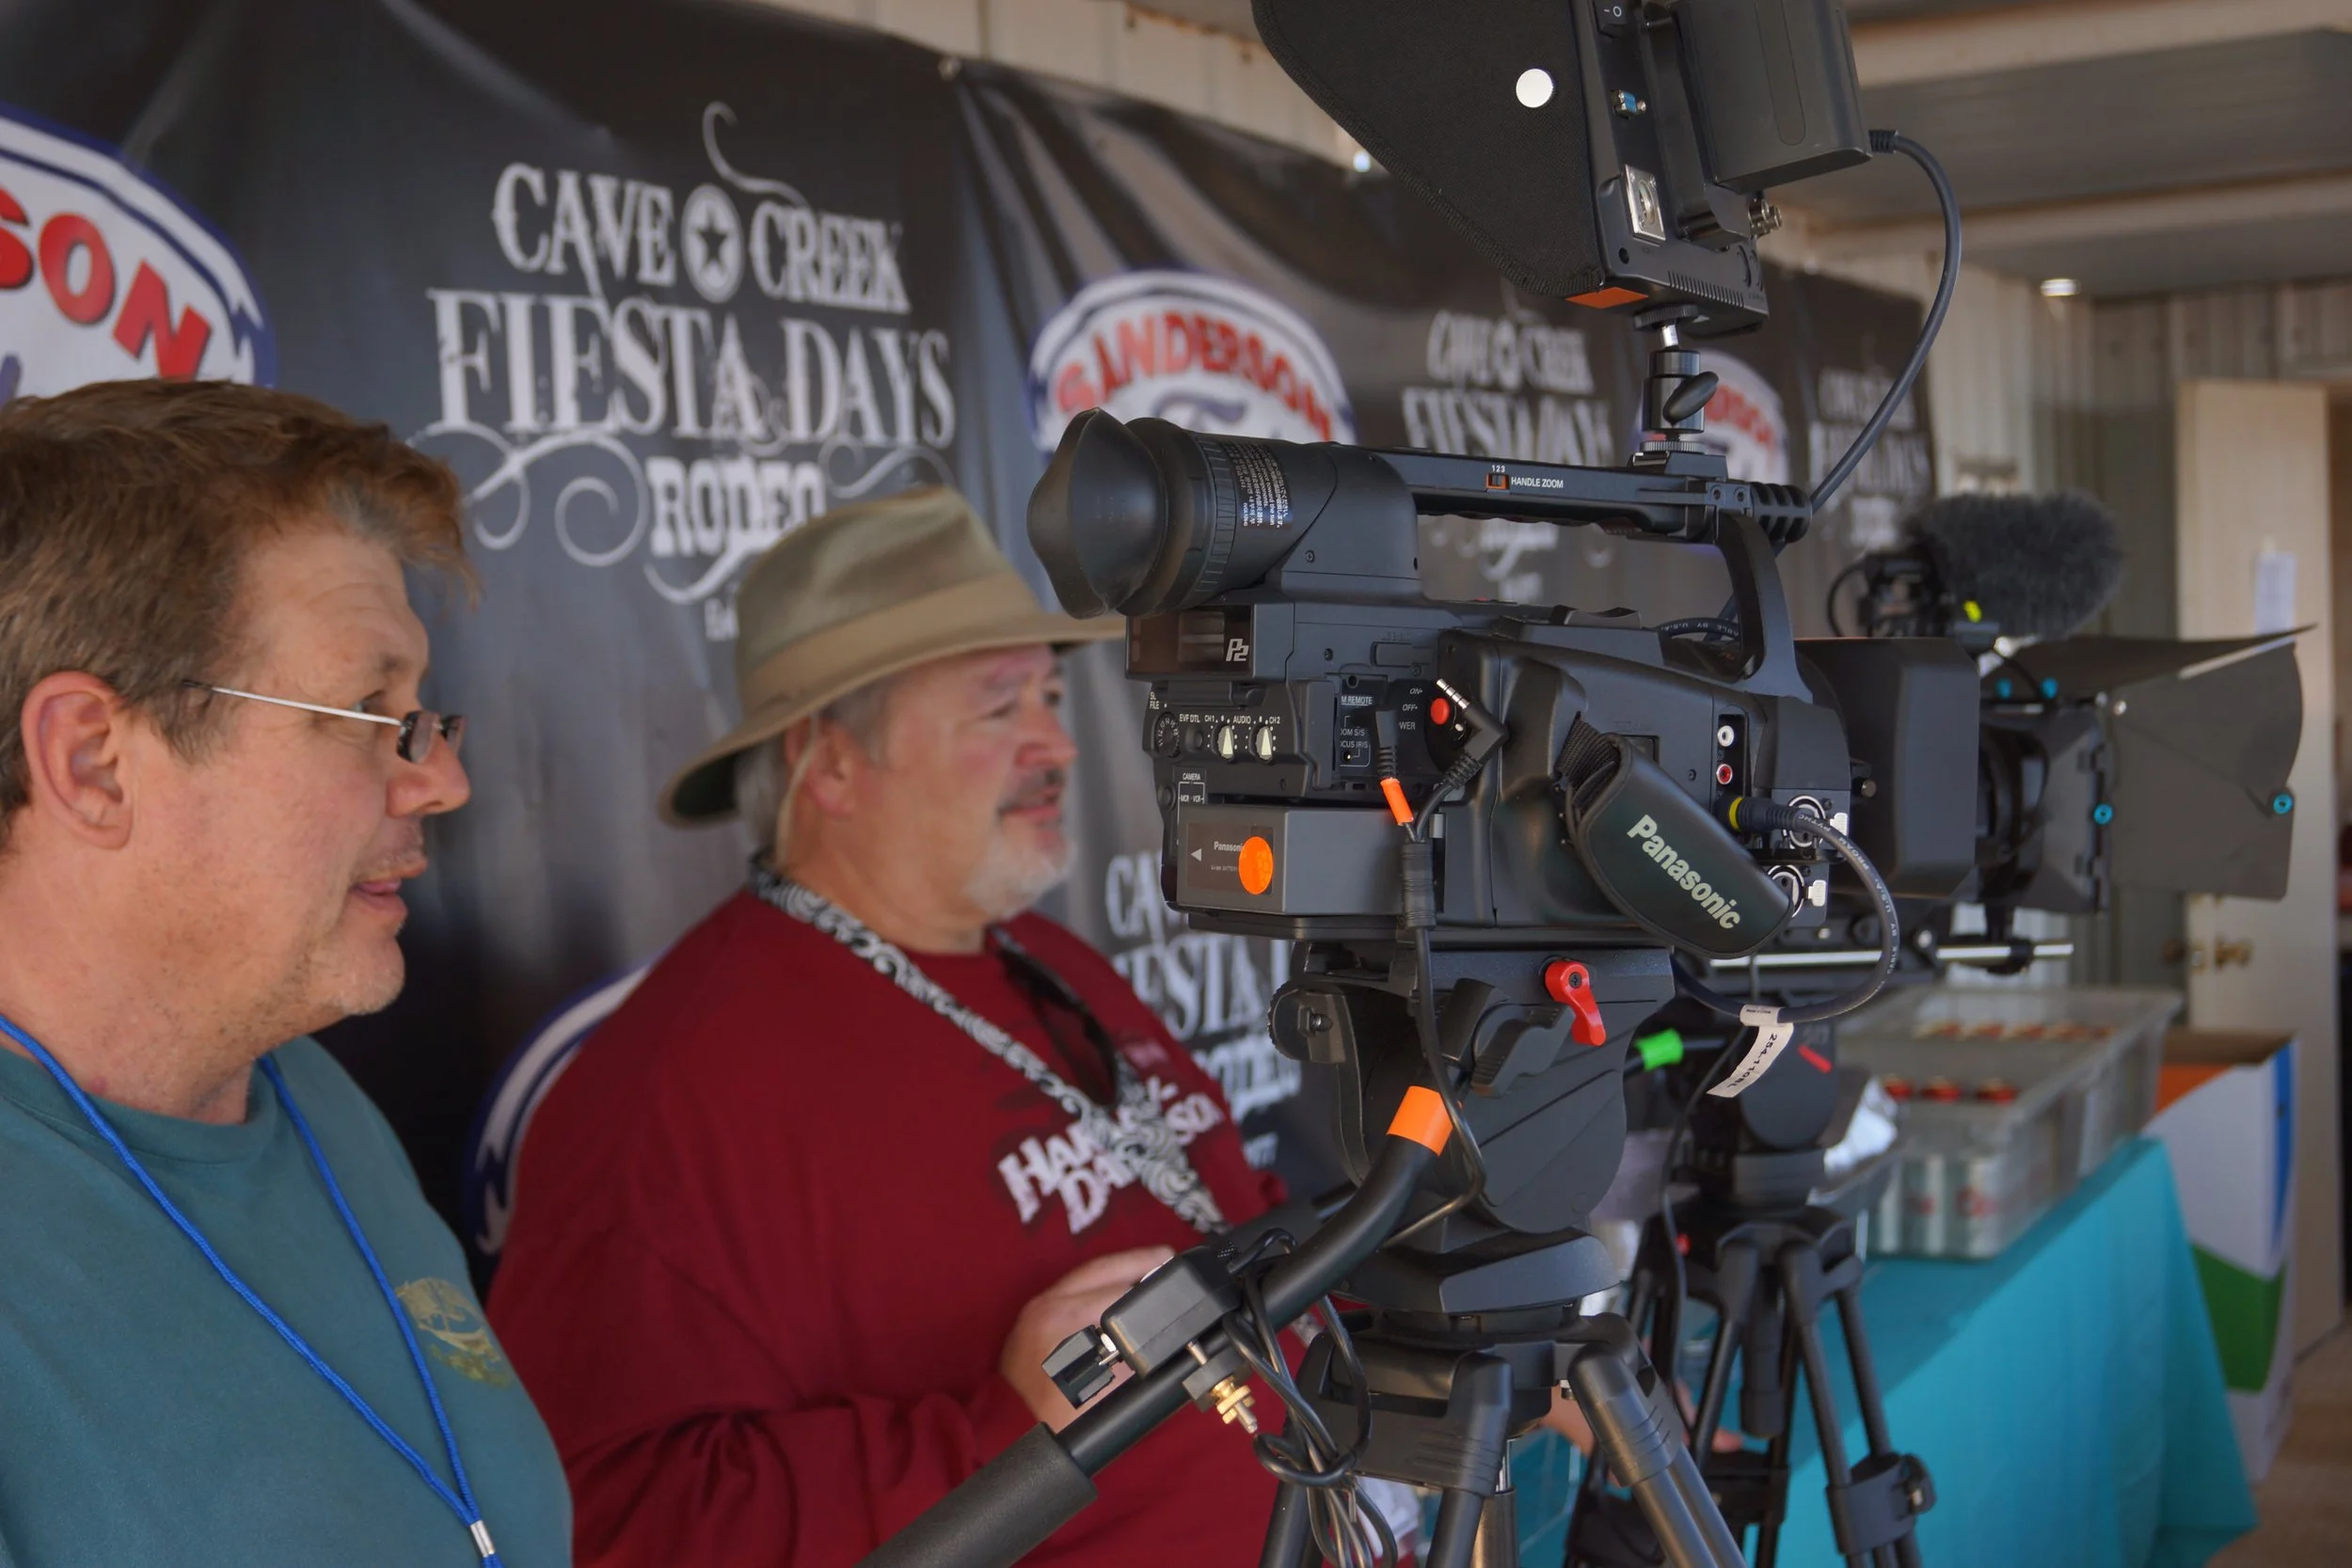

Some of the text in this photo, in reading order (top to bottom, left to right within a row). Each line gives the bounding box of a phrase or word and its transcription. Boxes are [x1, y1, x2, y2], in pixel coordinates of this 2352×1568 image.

[491, 162, 911, 313] CAVE CREEK
[426, 287, 957, 449] FIESTA DAYS
[1056, 310, 1333, 442] SANDERSON
[1511, 476, 1564, 488] HANDLE ZOOM
[1226, 638, 1249, 662] P2
[1347, 696, 1373, 705] REMOTE
[1179, 714, 1200, 723] EVF DTL
[1398, 721, 1415, 730] WER
[1798, 813, 1832, 832] PYTHO
[1214, 841, 1243, 852] Panasoni
[1627, 815, 1740, 929] Panasonic
